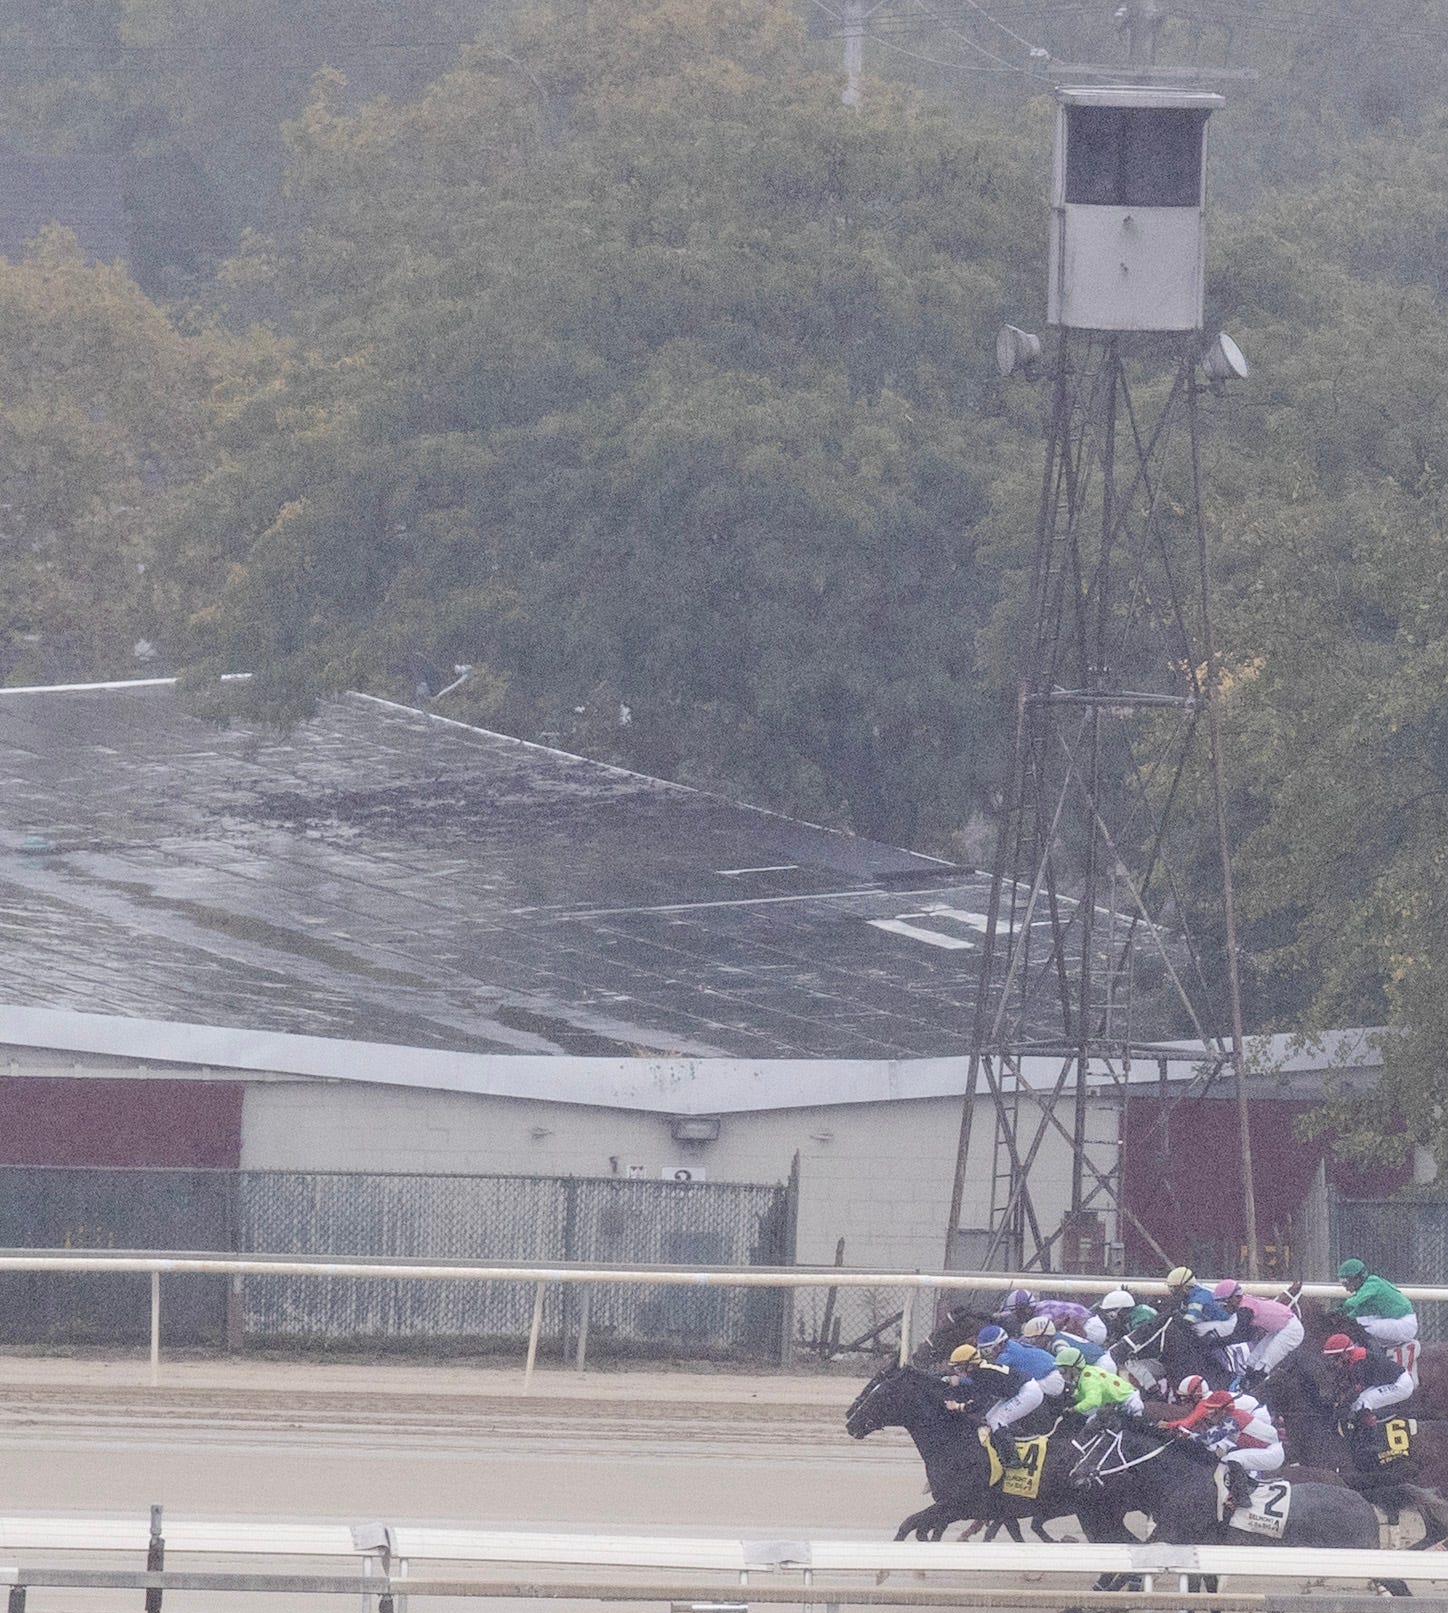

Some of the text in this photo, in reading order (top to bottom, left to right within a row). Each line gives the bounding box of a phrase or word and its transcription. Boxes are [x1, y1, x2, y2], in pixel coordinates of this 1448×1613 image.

[1394, 1343, 1415, 1375] 11
[1385, 1419, 1410, 1451] 6
[1021, 1444, 1039, 1477] 4
[1264, 1484, 1287, 1518] 2
